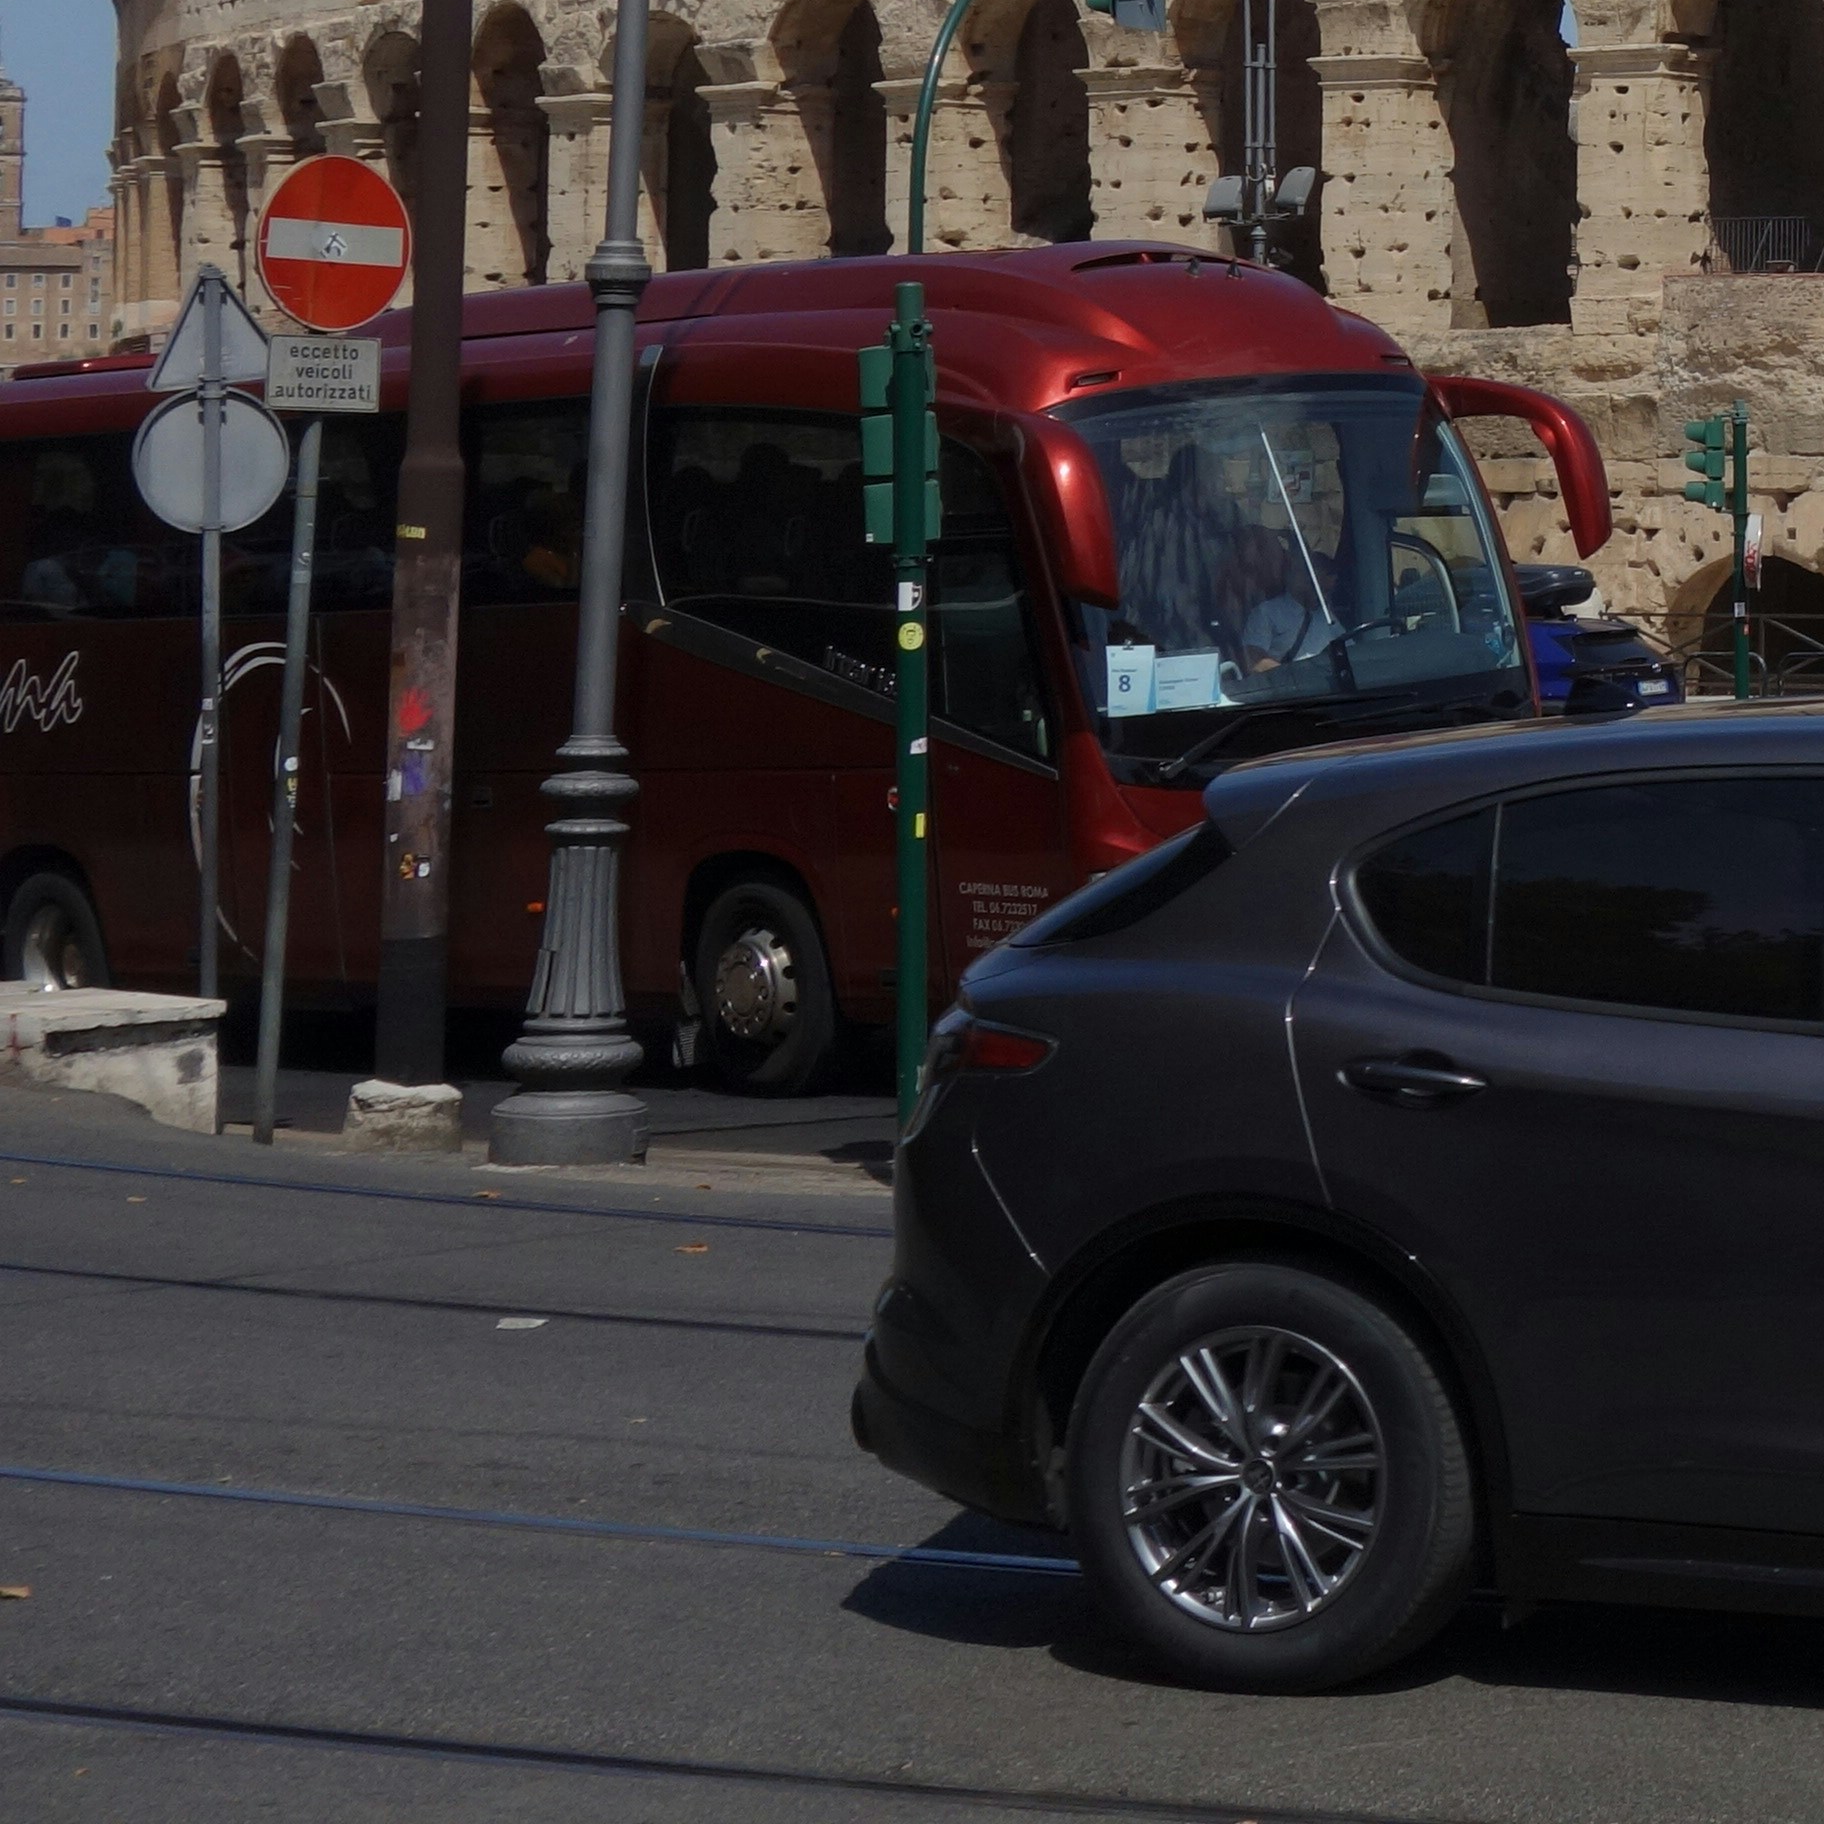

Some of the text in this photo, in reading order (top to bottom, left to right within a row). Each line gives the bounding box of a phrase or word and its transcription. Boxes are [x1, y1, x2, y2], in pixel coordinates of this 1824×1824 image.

[289, 344, 359, 361] eccetto
[295, 364, 353, 380] veicoli
[274, 382, 372, 401] autorizzati
[1118, 674, 1132, 693] 8
[1020, 884, 1049, 898] ROMA
[972, 917, 991, 931] FAX
